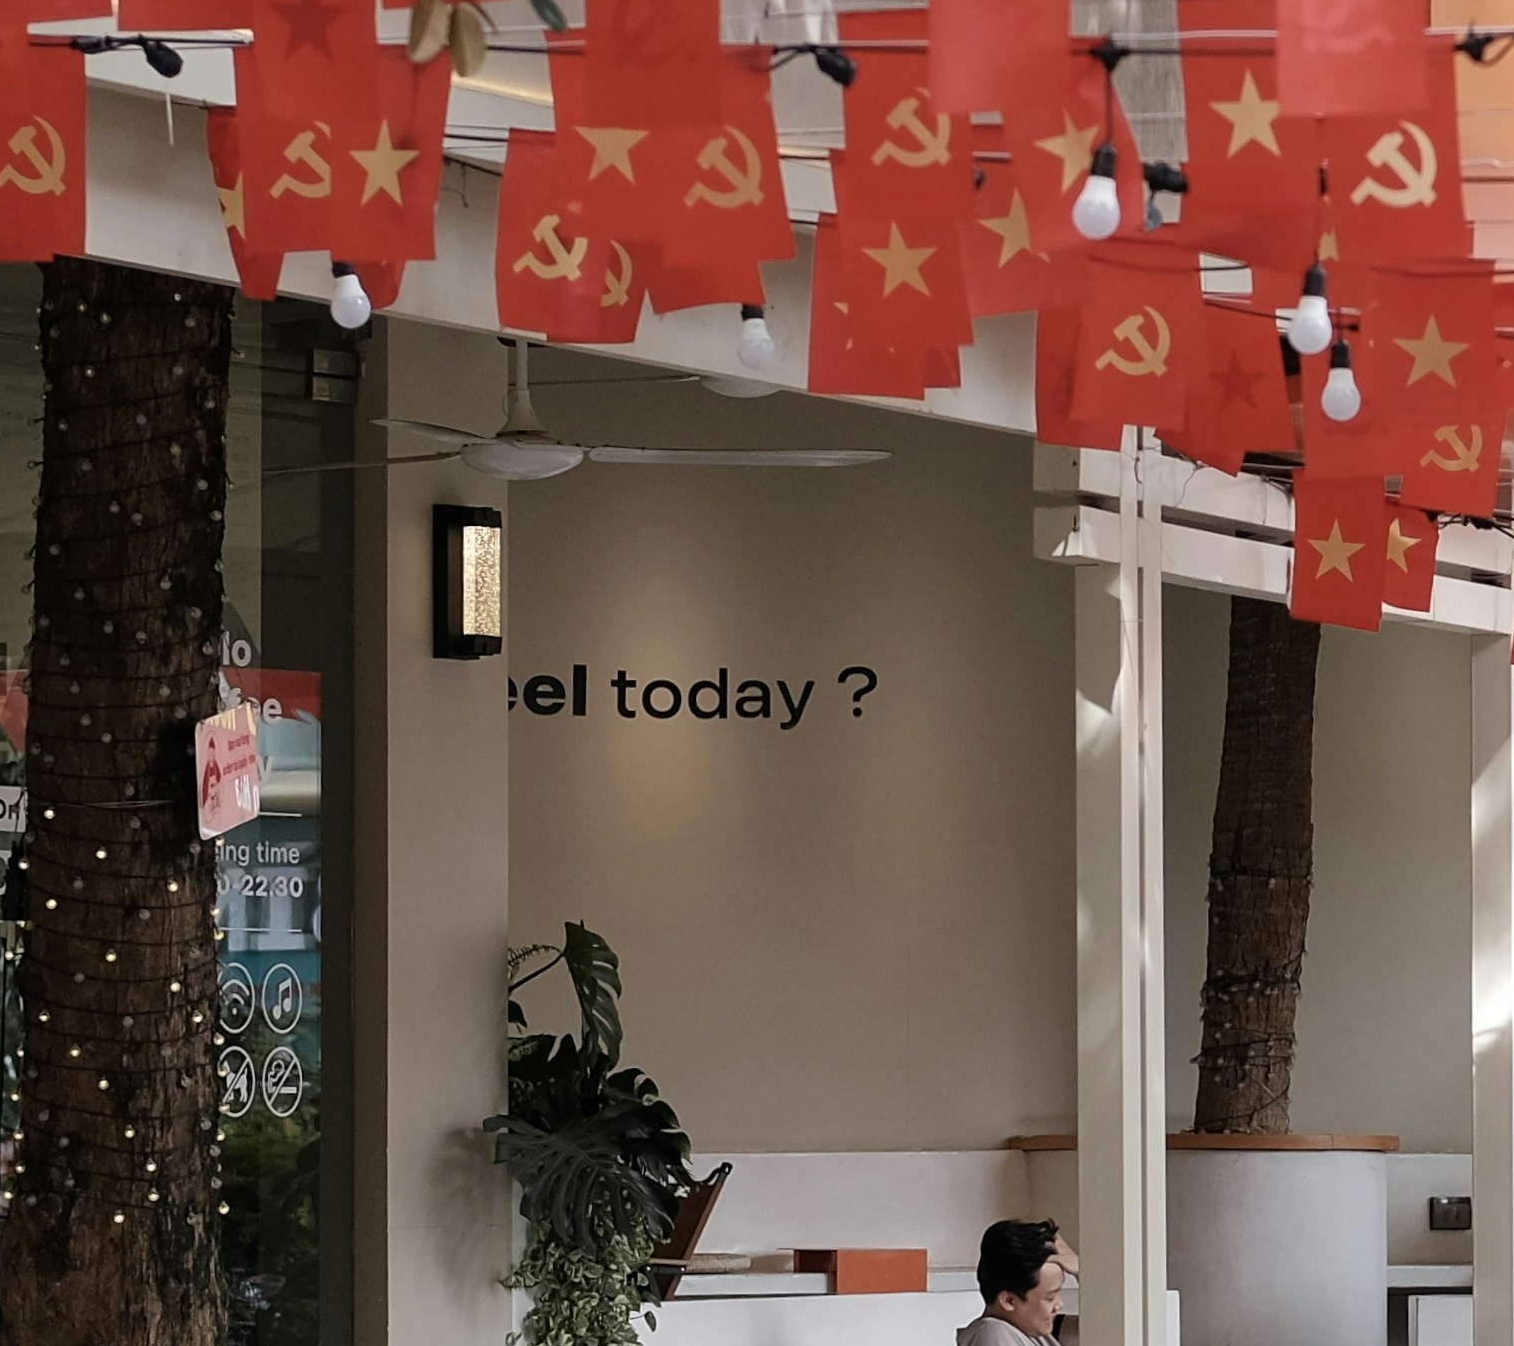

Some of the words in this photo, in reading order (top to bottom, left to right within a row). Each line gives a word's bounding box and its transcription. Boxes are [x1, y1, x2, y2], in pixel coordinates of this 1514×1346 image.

[508, 664, 587, 717] el
[611, 667, 816, 730] today
[837, 666, 879, 718] ?
[256, 841, 300, 864] time
